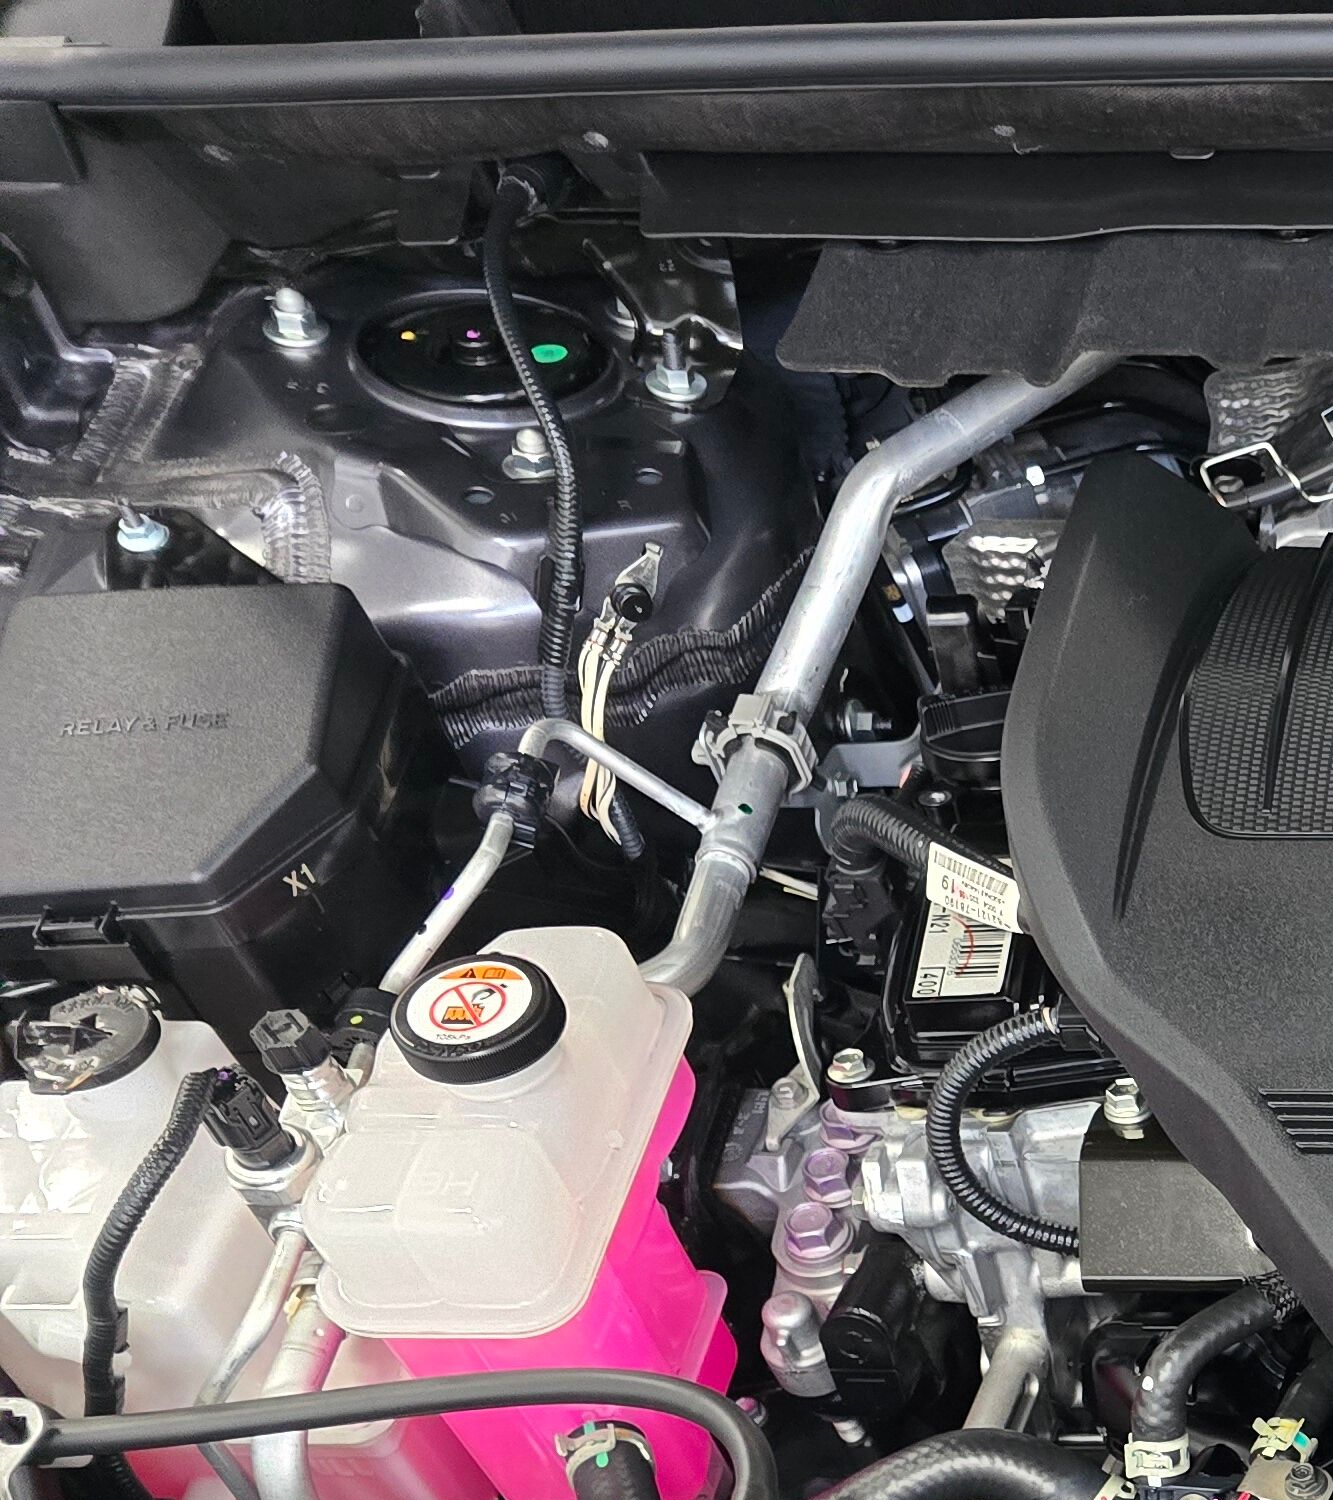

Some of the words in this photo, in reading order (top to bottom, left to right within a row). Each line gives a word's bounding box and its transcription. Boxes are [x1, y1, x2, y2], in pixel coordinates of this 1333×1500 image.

[61, 715, 139, 737] RELAY
[282, 862, 317, 897] X1
[916, 972, 939, 996] 400
